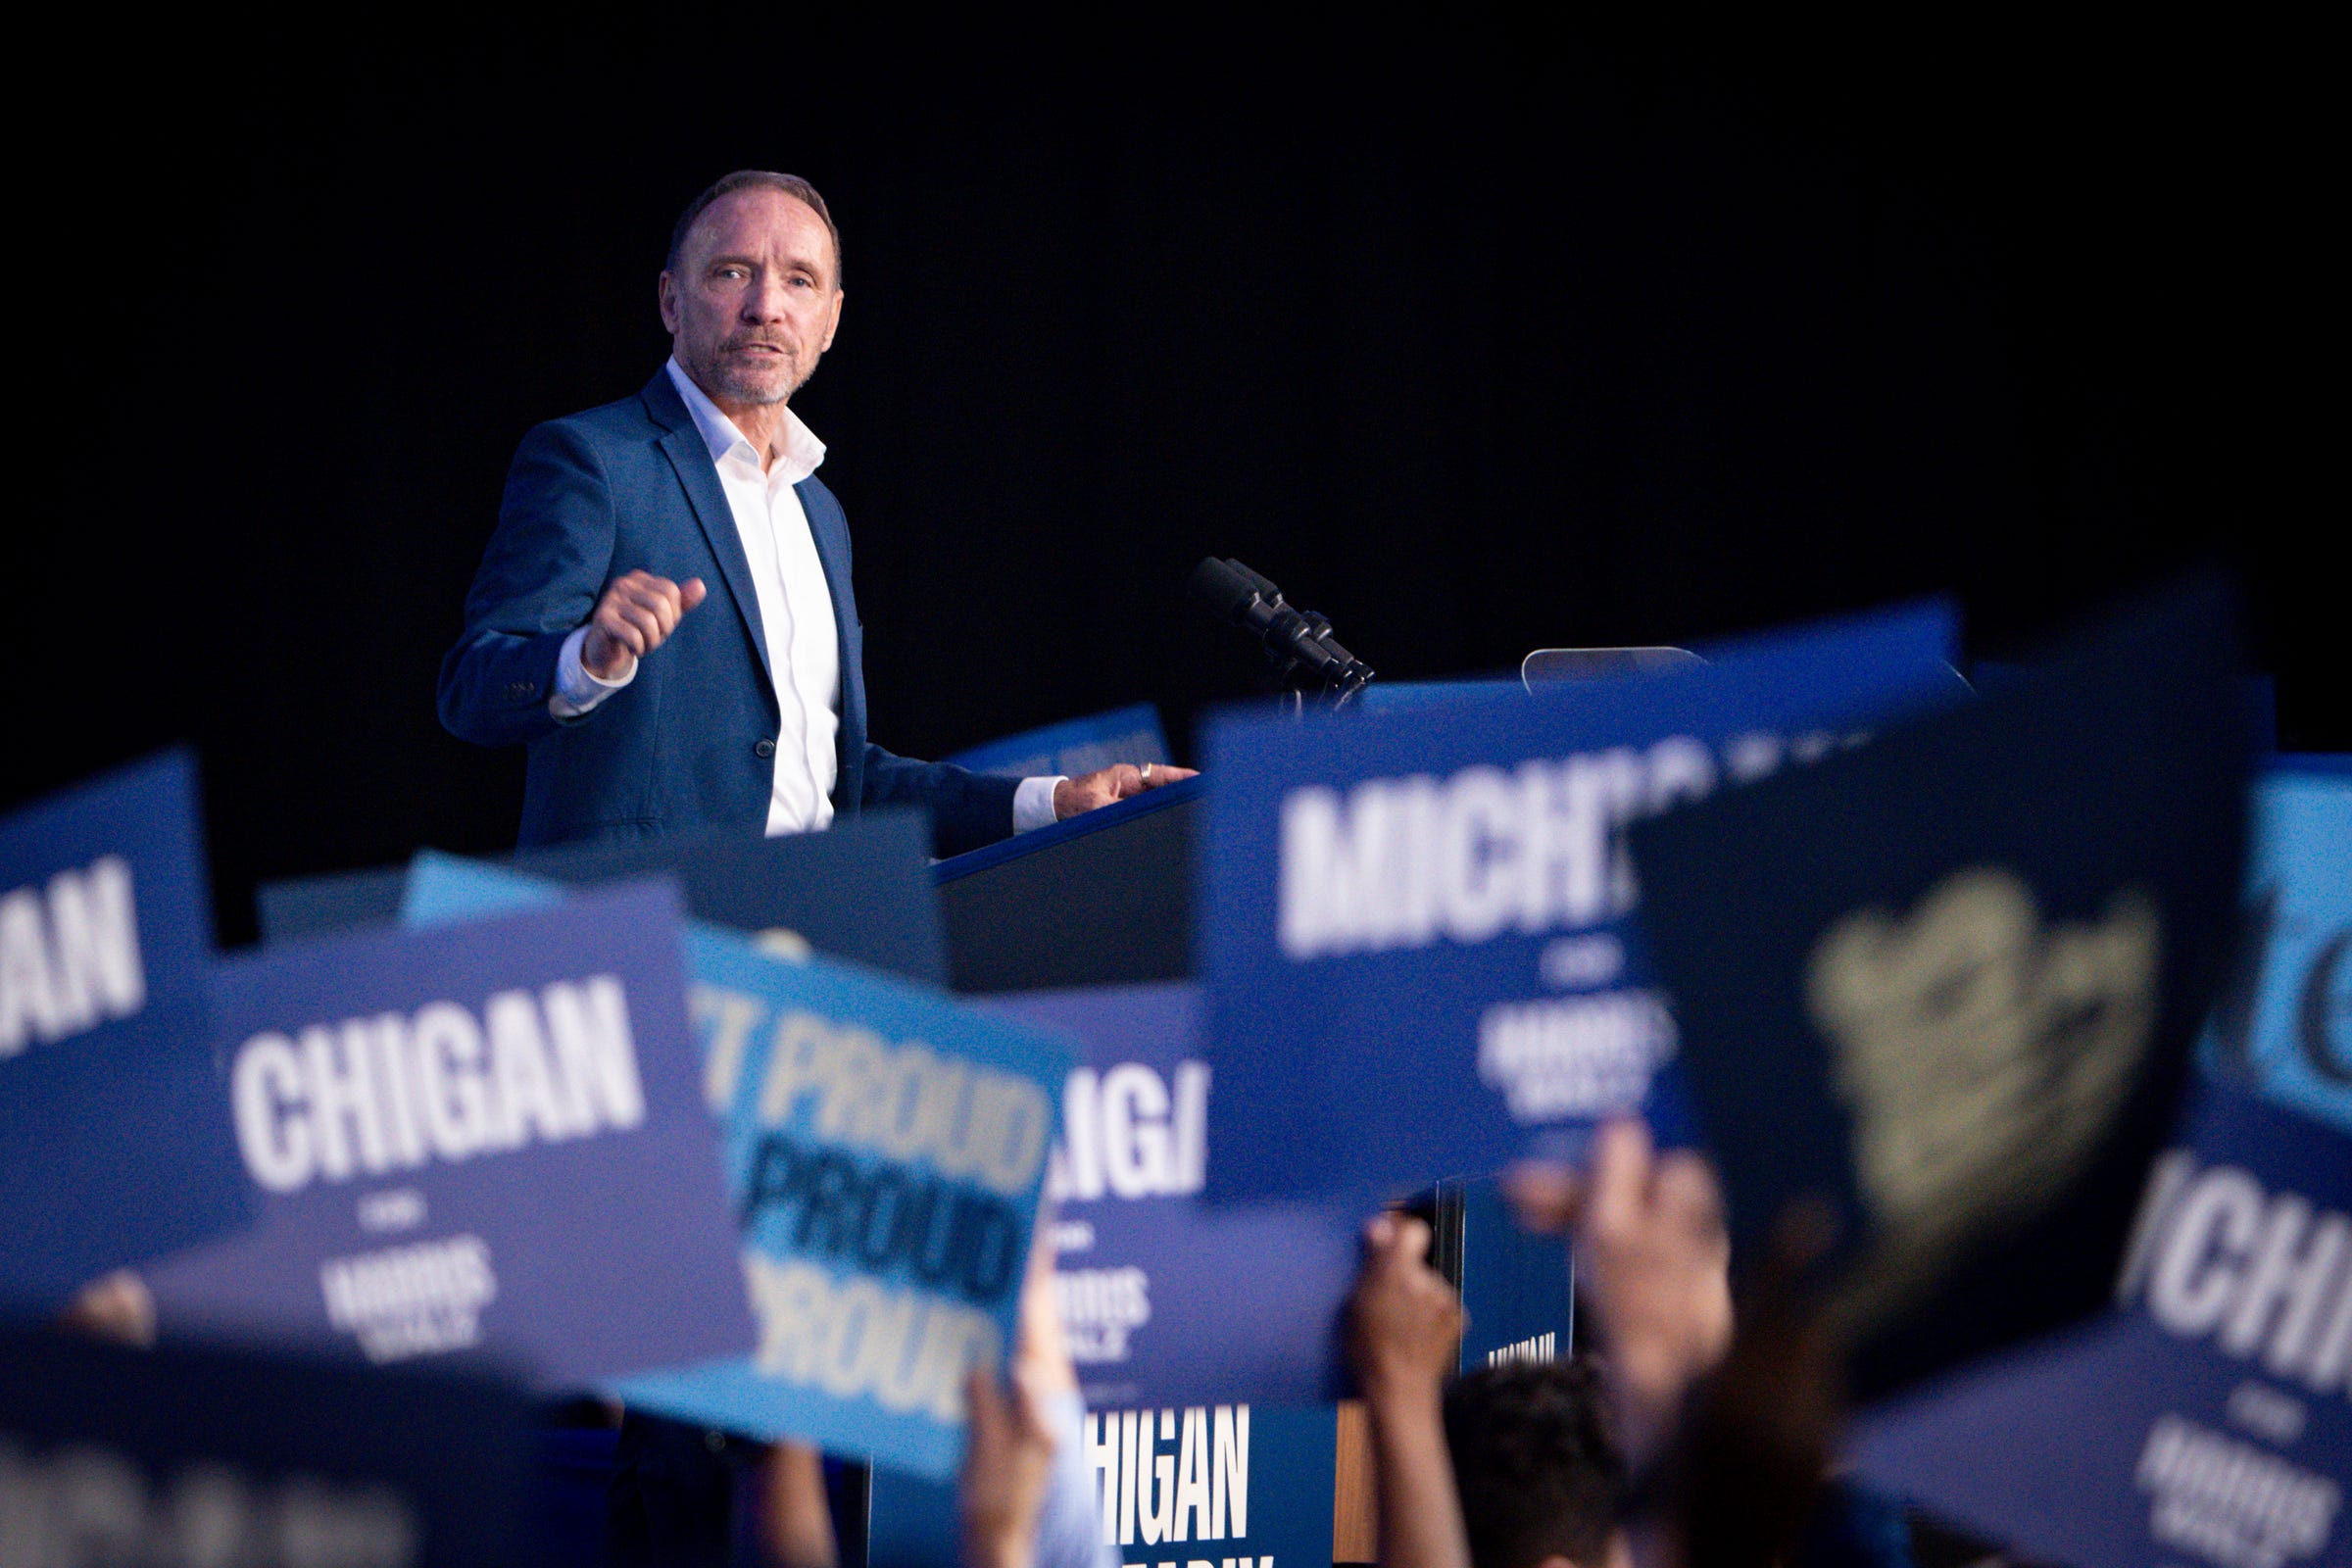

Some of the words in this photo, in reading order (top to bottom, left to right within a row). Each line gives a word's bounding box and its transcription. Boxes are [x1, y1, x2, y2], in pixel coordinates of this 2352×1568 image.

[1282, 733, 1784, 960] MICH
[232, 975, 645, 1192] CHIGAN
[760, 1009, 1054, 1194] PROUD
[742, 1135, 1019, 1305] PROUD
[1083, 1403, 1250, 1545] HIGAN
